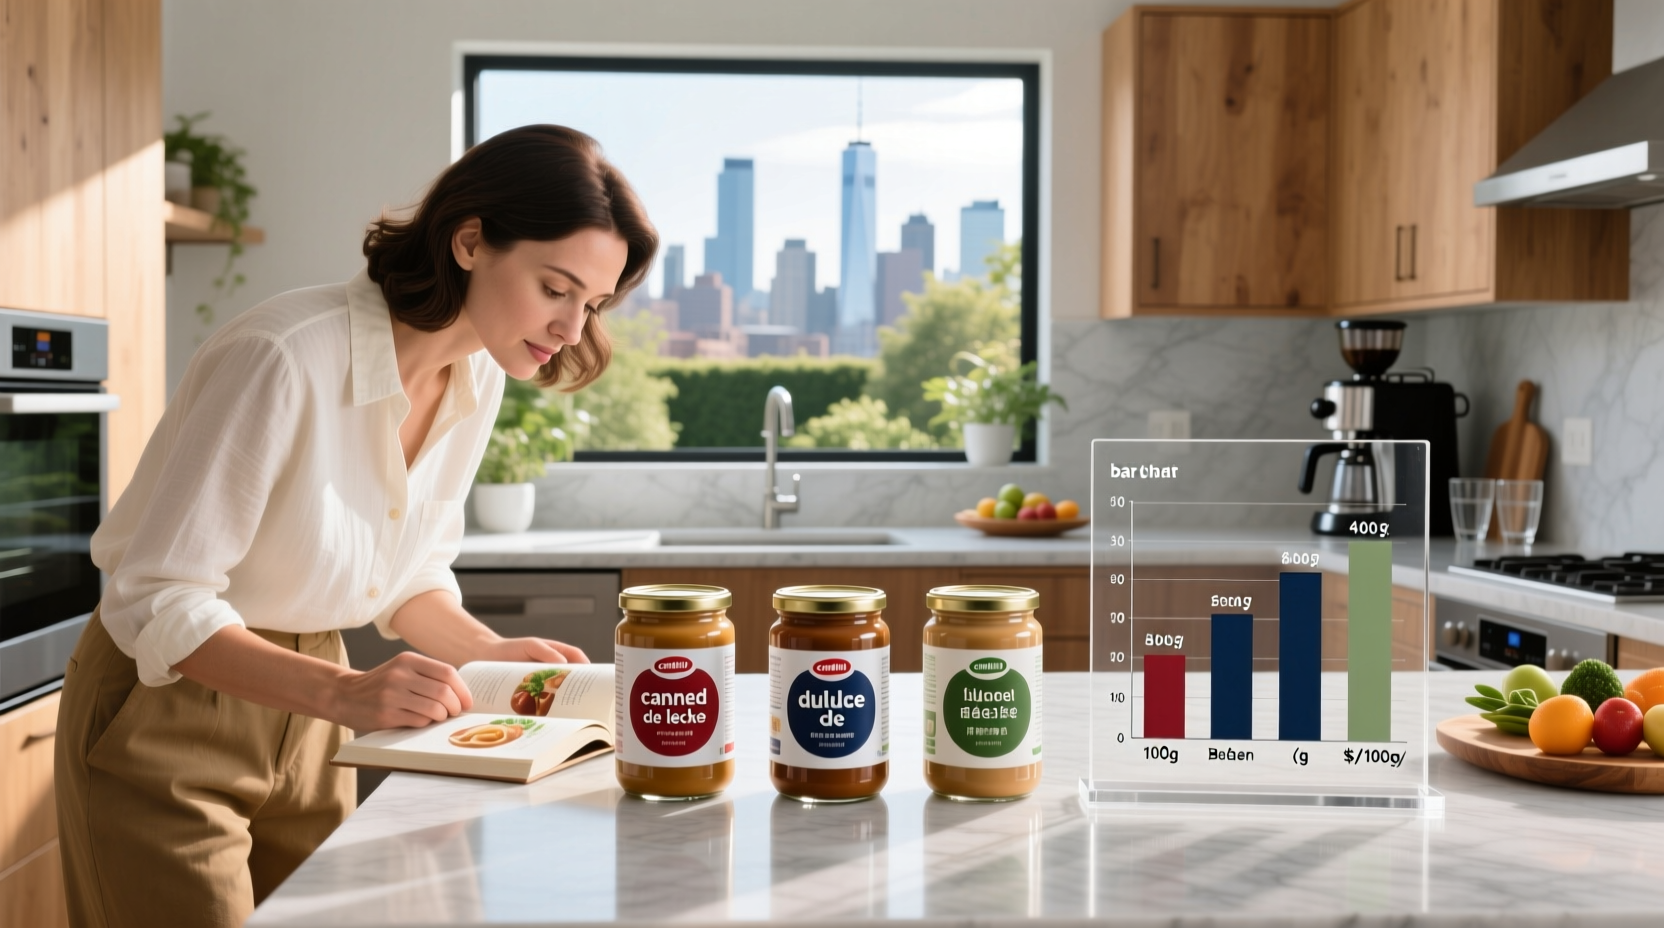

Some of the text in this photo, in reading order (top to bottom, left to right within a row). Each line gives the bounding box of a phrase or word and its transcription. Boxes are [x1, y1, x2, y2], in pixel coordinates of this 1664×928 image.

[641, 687, 707, 706] canned
[643, 709, 662, 724] de
[819, 709, 845, 727] de
[1117, 733, 1125, 743] 0
[1144, 746, 1179, 764] 100g
